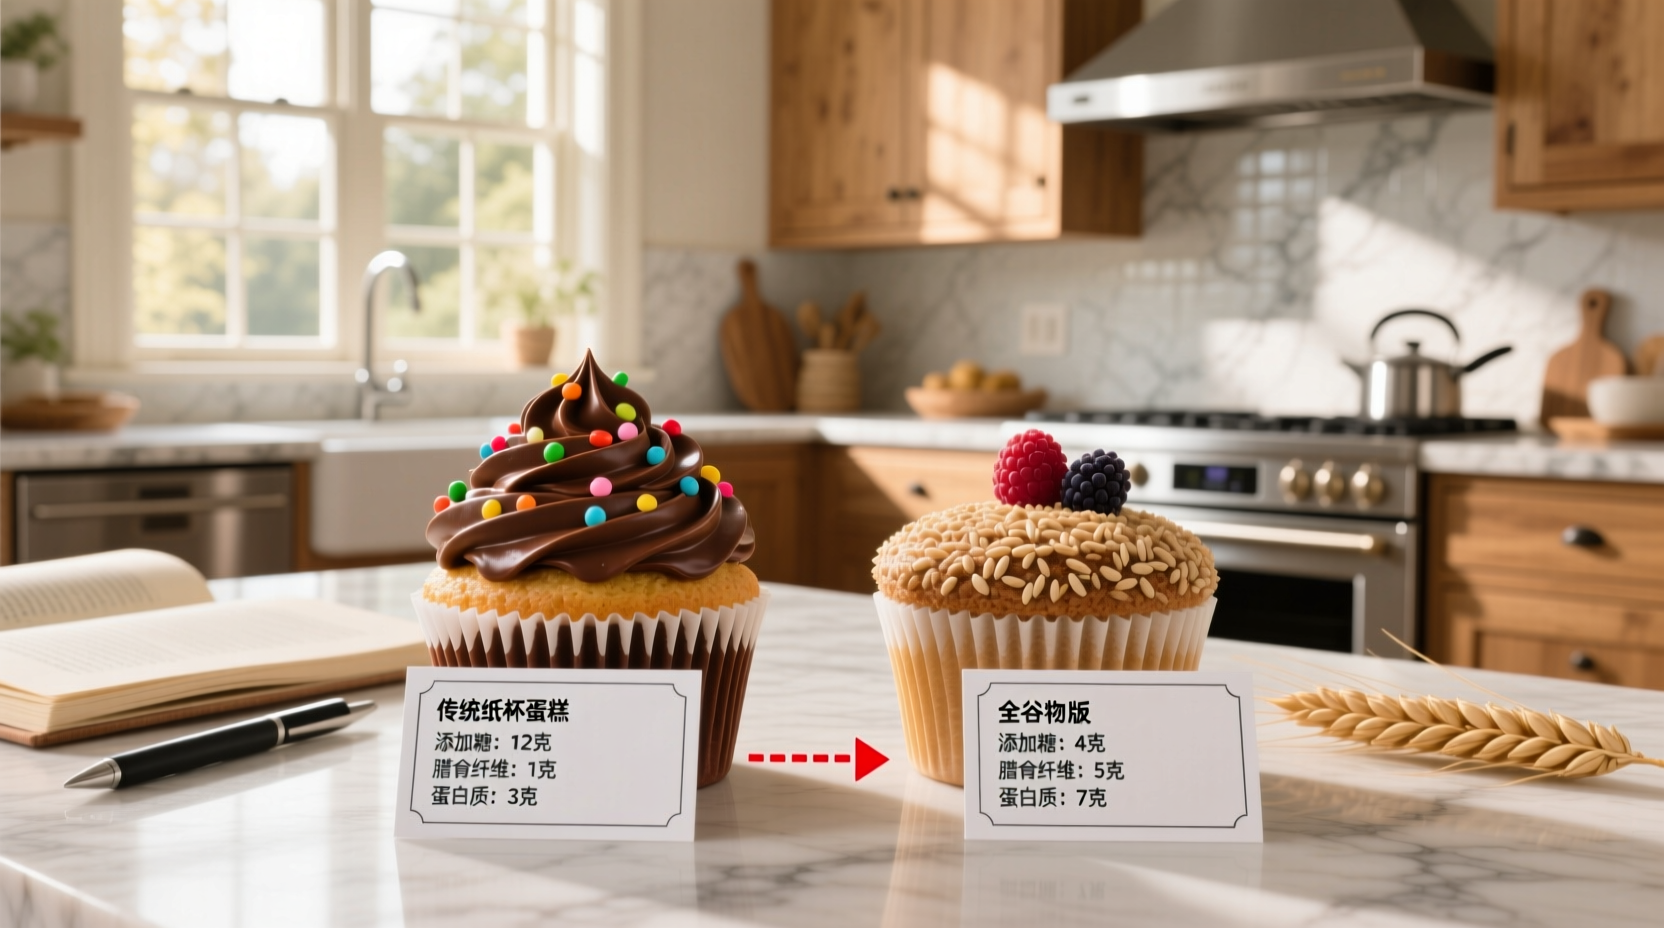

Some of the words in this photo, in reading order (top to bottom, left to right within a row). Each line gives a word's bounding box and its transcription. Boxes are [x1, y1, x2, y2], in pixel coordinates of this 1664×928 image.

[436, 697, 570, 723] 传统纸杯蛋糕
[998, 699, 1092, 725] 全谷物版
